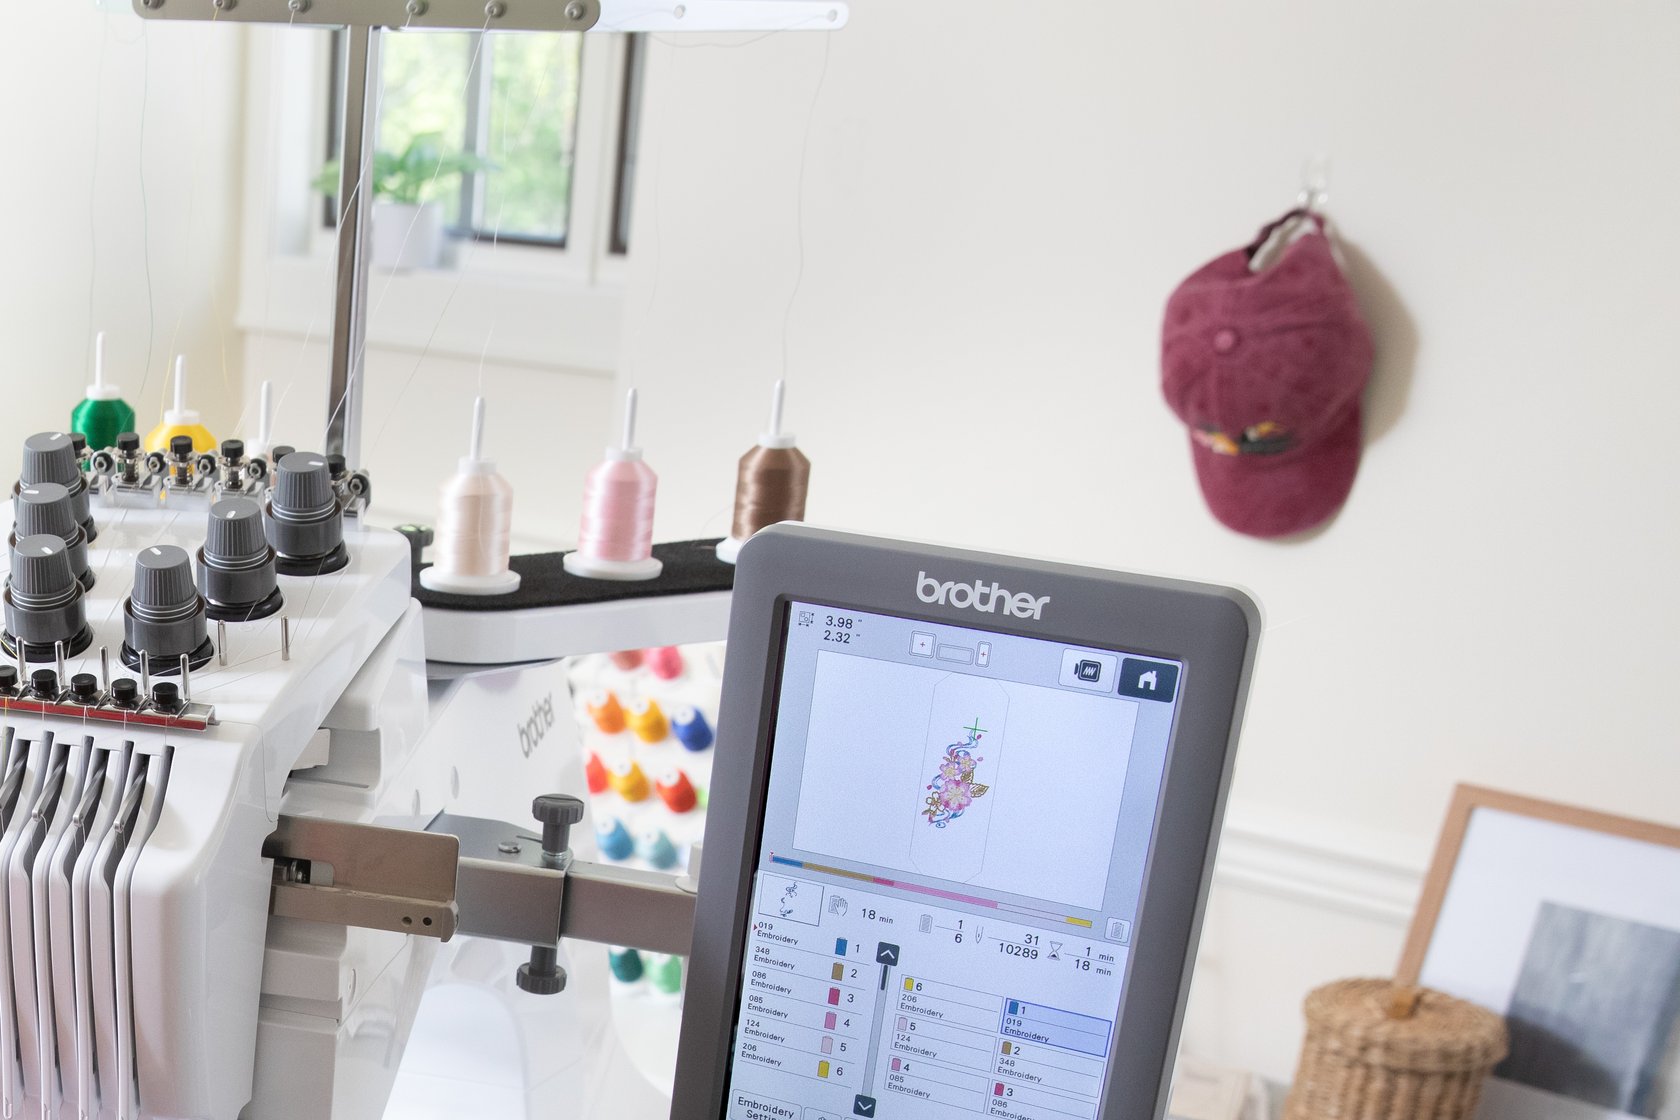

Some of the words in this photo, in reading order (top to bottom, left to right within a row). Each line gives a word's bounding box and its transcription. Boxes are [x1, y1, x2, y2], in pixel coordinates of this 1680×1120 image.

[915, 571, 1051, 621] brother
[825, 616, 853, 630] 3.98
[824, 630, 851, 644] 2.32
[517, 691, 556, 759] brother
[862, 908, 876, 920] 18
[879, 915, 894, 924] min
[758, 921, 773, 931] 019
[958, 919, 963, 930] 1
[757, 929, 798, 945] Embroidery
[955, 934, 963, 944] 6
[1025, 934, 1039, 945] 31
[755, 946, 770, 956] 348
[855, 944, 860, 953] 1
[999, 942, 1038, 960] 10289
[1086, 946, 1091, 957] 1
[1099, 953, 1114, 963] min
[754, 954, 795, 970] Embroidery
[1075, 959, 1091, 971] 18
[1095, 967, 1112, 977] min
[752, 970, 767, 980] 086
[850, 968, 858, 979] 2
[750, 978, 792, 995] Embroidery
[915, 982, 923, 992] 6
[749, 995, 763, 1004] 085
[847, 993, 855, 1003] 3
[901, 994, 917, 1004] 206
[747, 1003, 789, 1019] Embroidery
[900, 1002, 944, 1019] Embroidery
[1021, 1006, 1026, 1015] 1
[746, 1019, 760, 1028] 124
[843, 1018, 850, 1028] 4
[909, 1021, 916, 1031] 5
[1006, 1018, 1022, 1028] 019
[744, 1027, 785, 1043] Embroidery
[896, 1034, 911, 1043] 124
[1004, 1026, 1050, 1043] Embroidery
[742, 1043, 757, 1053] 206
[840, 1042, 847, 1052] 5
[895, 1042, 938, 1058] Embroidery
[1013, 1046, 1021, 1056] 2
[741, 1051, 782, 1067] Embroidery
[999, 1058, 1016, 1068] 348
[836, 1066, 844, 1076] 6
[903, 1063, 910, 1072] 4
[889, 1074, 904, 1083] 085
[997, 1066, 1042, 1083] Embroidery
[888, 1082, 931, 1099] Embroidery
[1006, 1087, 1014, 1097] 3
[738, 1096, 794, 1119] Embroidery
[992, 1098, 1008, 1108] 086
